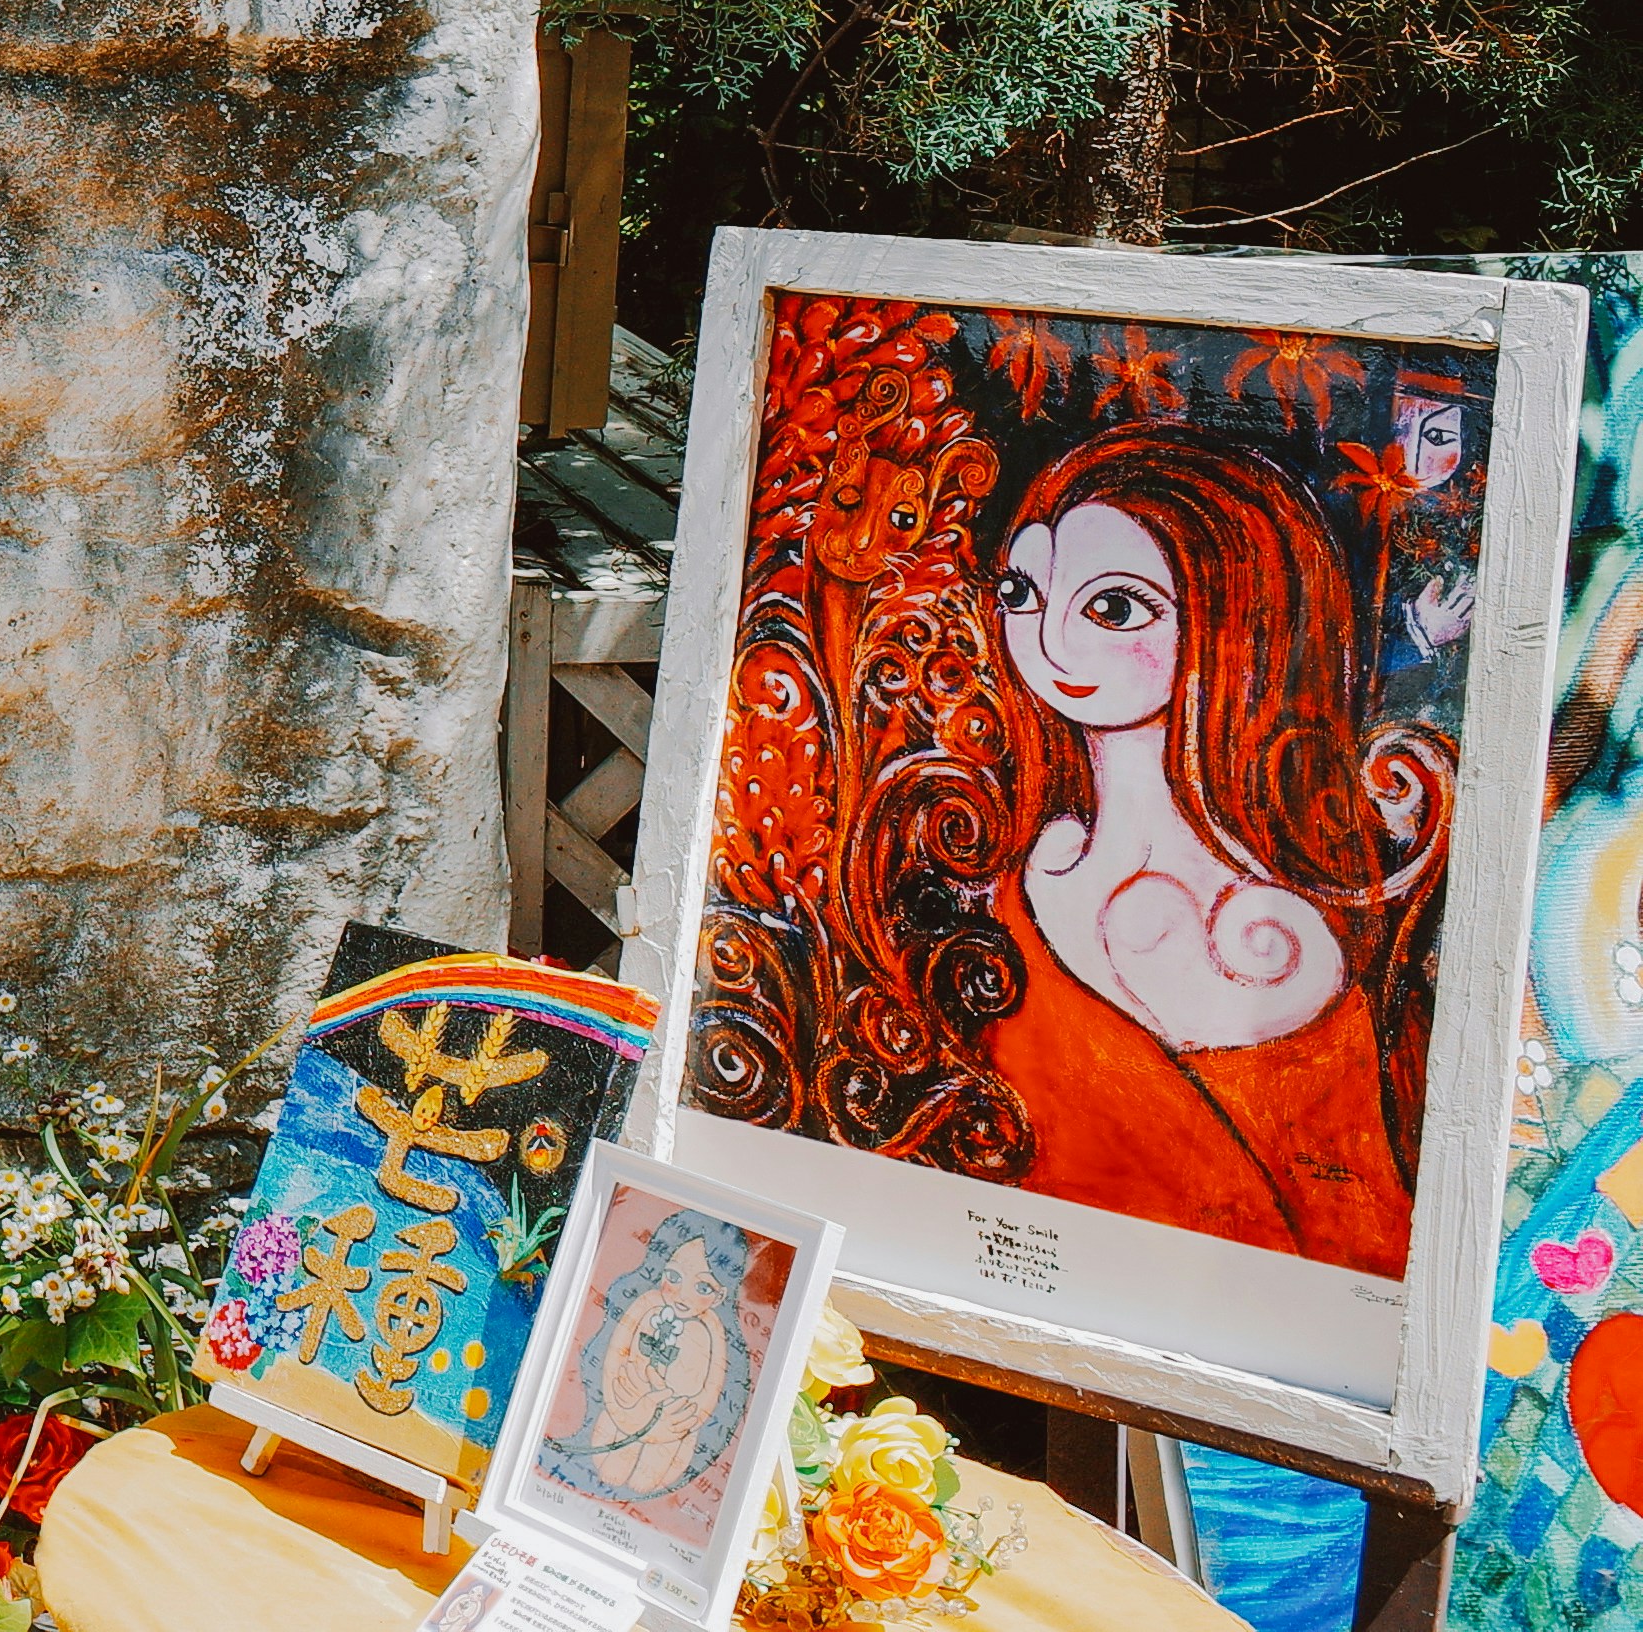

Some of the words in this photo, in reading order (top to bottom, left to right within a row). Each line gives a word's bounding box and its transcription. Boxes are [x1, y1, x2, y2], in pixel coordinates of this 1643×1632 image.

[967, 1209, 987, 1224] For
[995, 1217, 1020, 1232] Your
[1027, 1224, 1059, 1241] Smile
